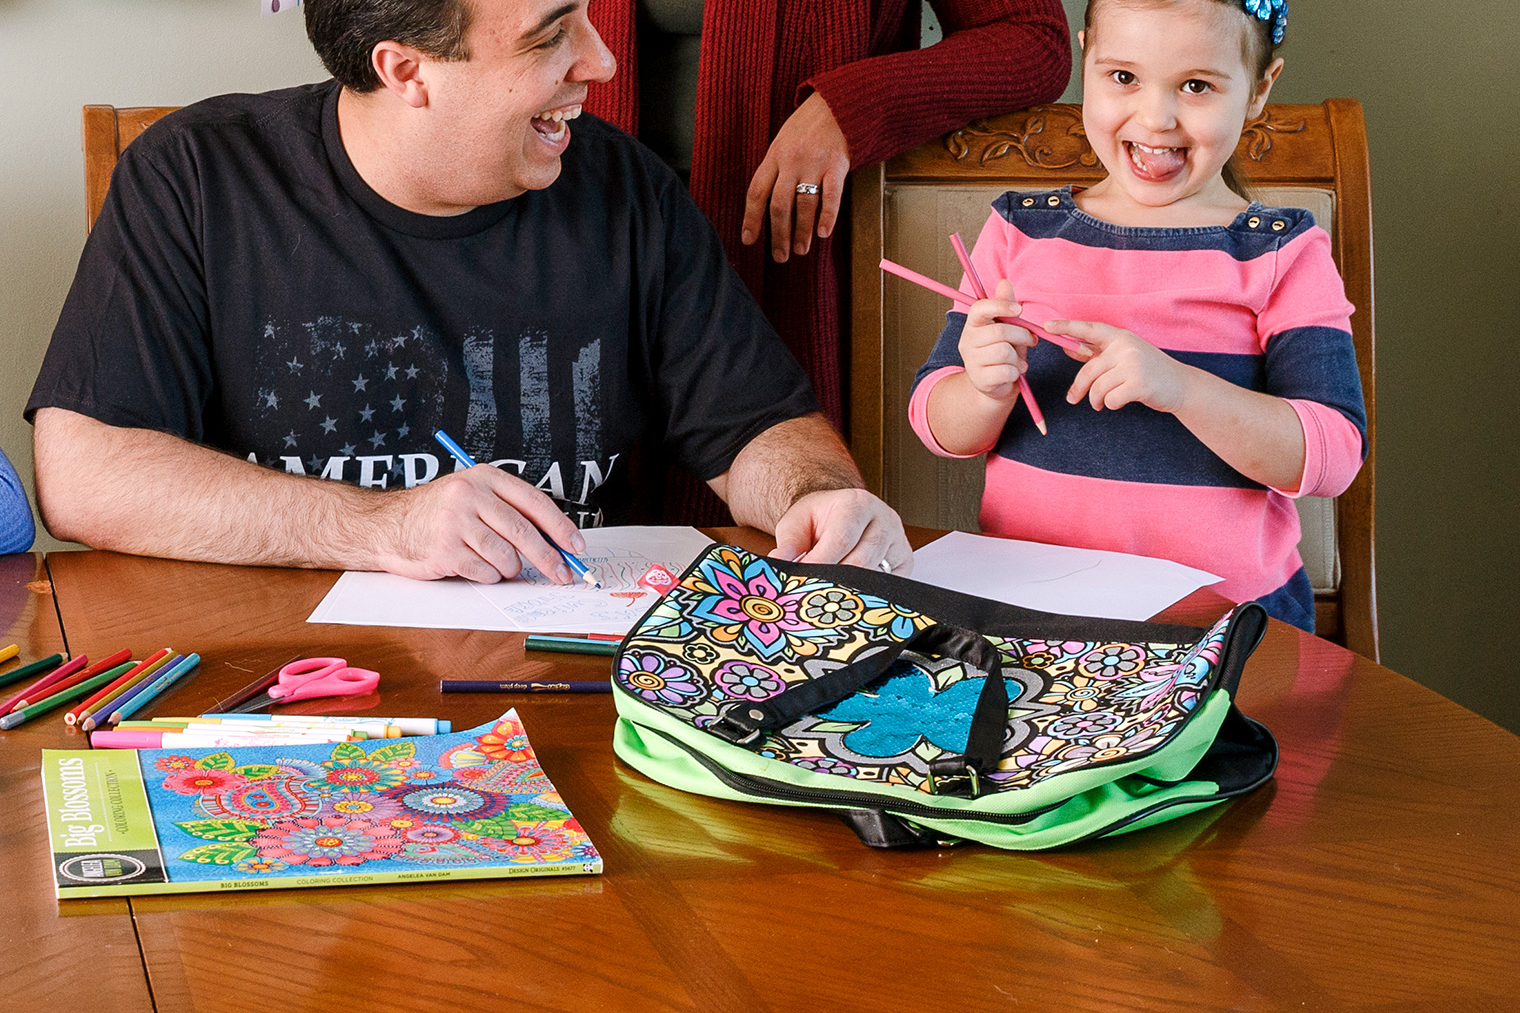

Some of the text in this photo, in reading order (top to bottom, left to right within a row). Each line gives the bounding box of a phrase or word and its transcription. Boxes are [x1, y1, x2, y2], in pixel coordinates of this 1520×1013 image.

[58, 757, 93, 822] Blossoms
[105, 772, 129, 833] COLORING COLLECTION
[59, 824, 105, 847] Big
[234, 880, 269, 888] BLOSSOMS
